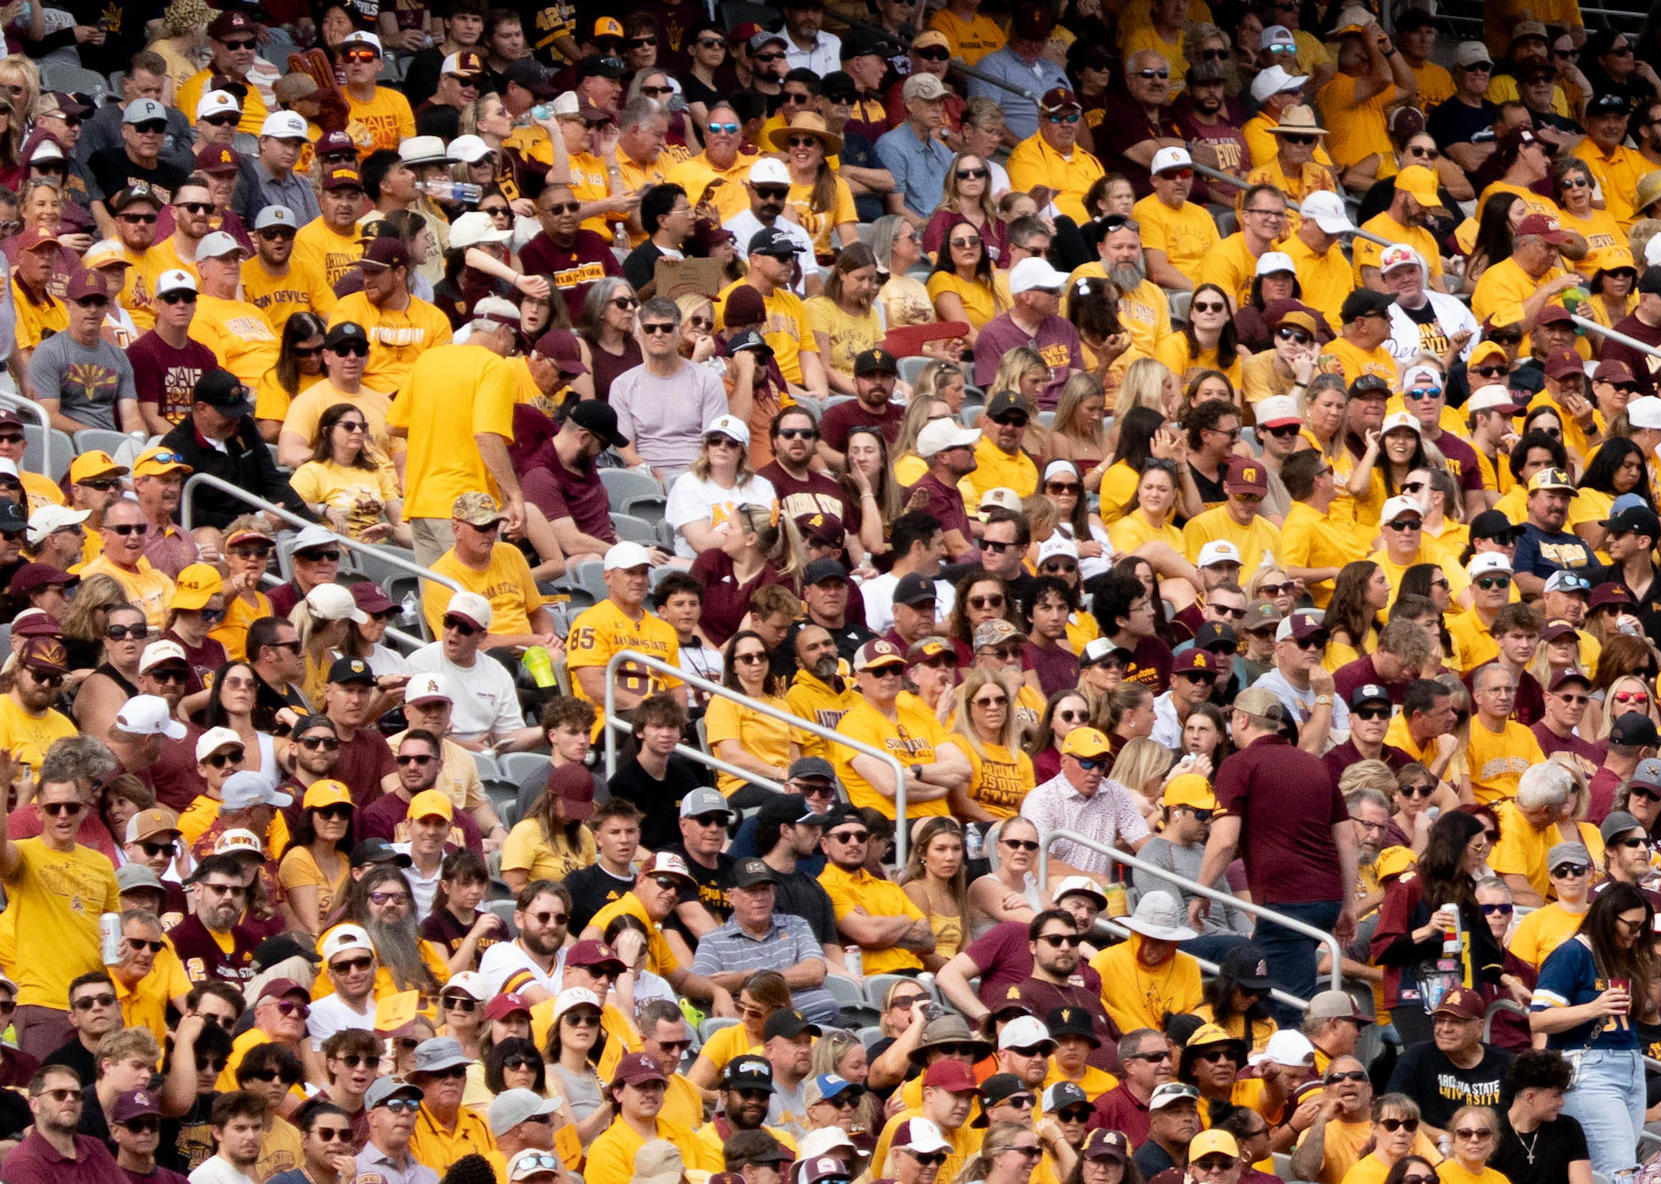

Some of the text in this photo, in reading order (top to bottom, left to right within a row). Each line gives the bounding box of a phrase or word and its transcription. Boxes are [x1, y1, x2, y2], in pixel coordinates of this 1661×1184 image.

[145, 102, 156, 114] P
[273, 289, 310, 304] DEVILS
[569, 628, 597, 654] 85
[1472, 1079, 1500, 1094] STATE
